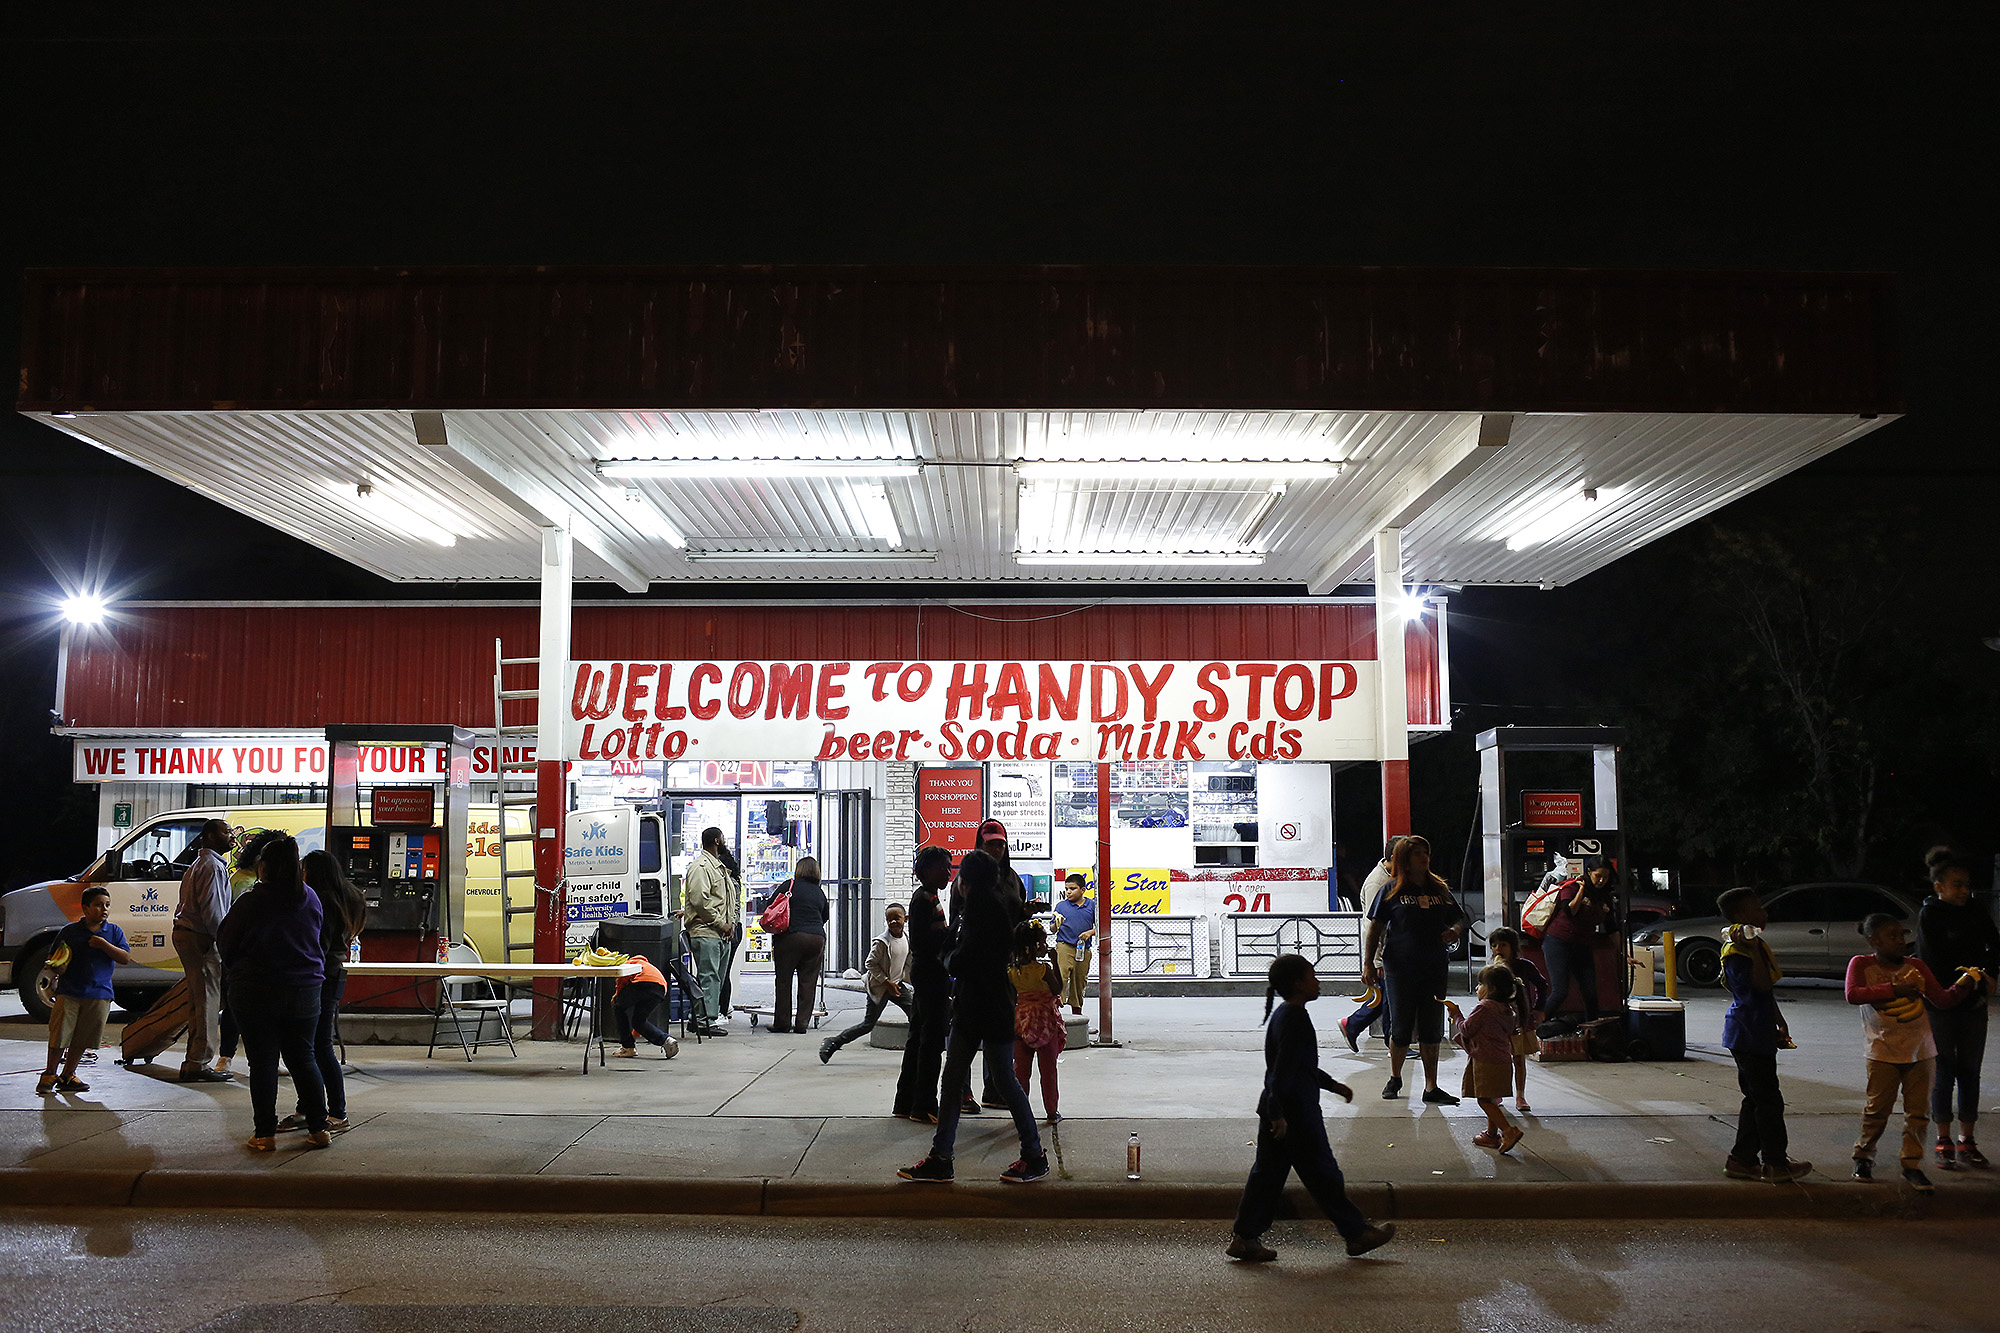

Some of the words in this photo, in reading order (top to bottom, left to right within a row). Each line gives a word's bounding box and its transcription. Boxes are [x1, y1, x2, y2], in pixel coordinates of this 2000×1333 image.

[571, 662, 850, 721] WELCOME
[864, 662, 933, 702] TO
[945, 662, 1174, 722] HANDY
[1193, 662, 1358, 722] STOP
[814, 723, 924, 761] beer
[939, 721, 1063, 761] Soda
[83, 748, 126, 775] WE
[135, 748, 224, 775] THANK
[232, 747, 283, 774] YOU
[295, 747, 326, 773] FO
[356, 746, 425, 773] YOUR
[436, 746, 572, 774] BSINE
[612, 760, 642, 773] ATM
[720, 759, 740, 773] 627
[704, 760, 770, 787] OPEN
[929, 779, 956, 787] THANK
[957, 779, 973, 787] YOU
[1210, 777, 1250, 790] OPEN
[924, 793, 938, 801] FOR
[938, 793, 978, 801] SHOPPING
[993, 790, 1012, 798] Stand
[1013, 791, 1022, 799] up
[391, 797, 425, 806] appreciate
[993, 800, 1017, 808] against
[1541, 799, 1576, 808] appreciate
[378, 805, 393, 813] your
[789, 804, 800, 812] NO
[1003, 809, 1018, 818] your
[1529, 808, 1544, 816] your
[1545, 807, 1578, 815] business!
[468, 822, 500, 834] ids
[565, 847, 592, 858] Safe
[596, 845, 624, 857] Kids
[571, 883, 593, 893] your
[596, 881, 621, 890] child
[1123, 873, 1168, 891] Star
[466, 888, 501, 896] CHEVROLET
[1228, 881, 1242, 893] We
[1244, 884, 1265, 896] open
[588, 892, 625, 904] safely?
[1223, 893, 1271, 912] 24
[129, 904, 149, 912] Safe
[151, 904, 169, 912] Kids
[1110, 899, 1161, 915] epted
[603, 911, 627, 920] System
[749, 952, 769, 960] EBT
